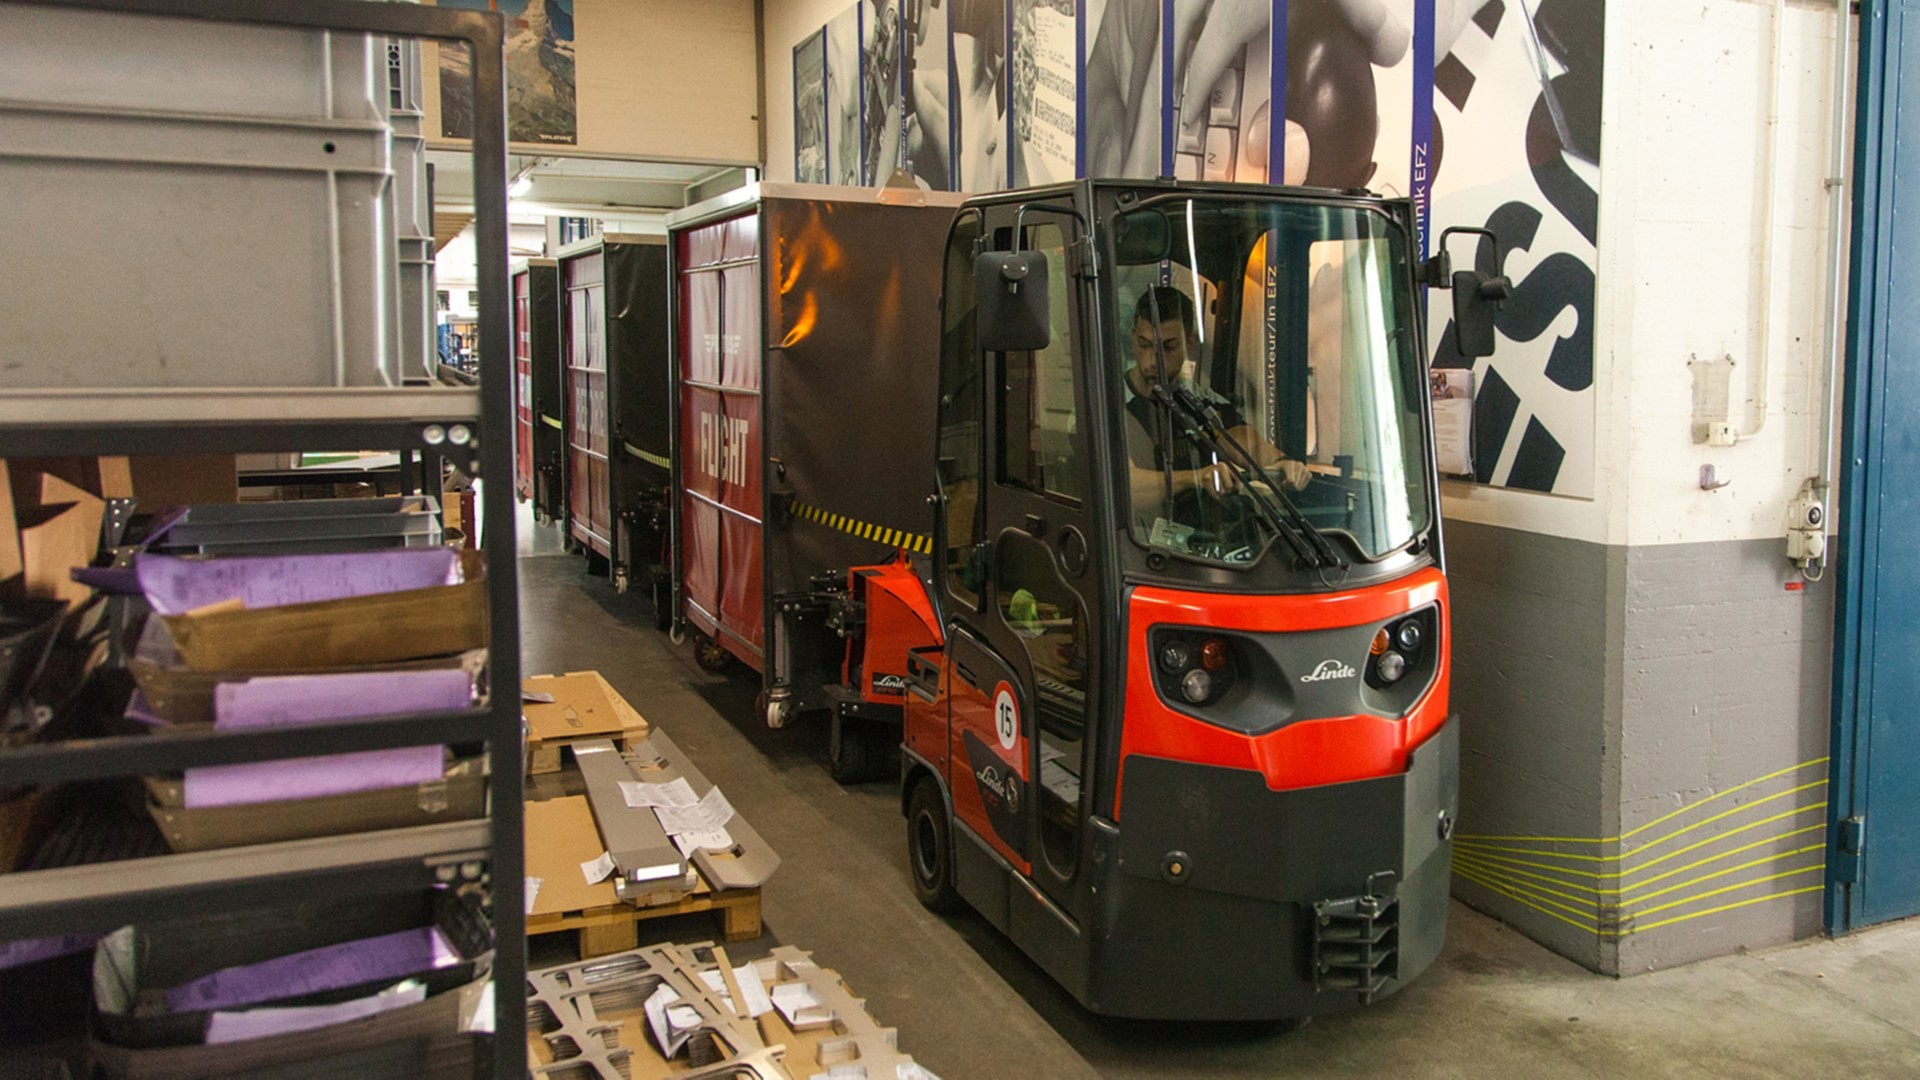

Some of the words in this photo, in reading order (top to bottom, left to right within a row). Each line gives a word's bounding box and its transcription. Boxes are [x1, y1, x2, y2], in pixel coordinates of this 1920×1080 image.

[1414, 142, 1427, 182] EFZ
[1267, 265, 1278, 298] EFZ
[701, 411, 749, 487] FLIGHT
[873, 675, 904, 687] Lind
[1300, 659, 1356, 683] Linde
[999, 702, 1013, 738] 15
[976, 765, 1005, 797] Linde
